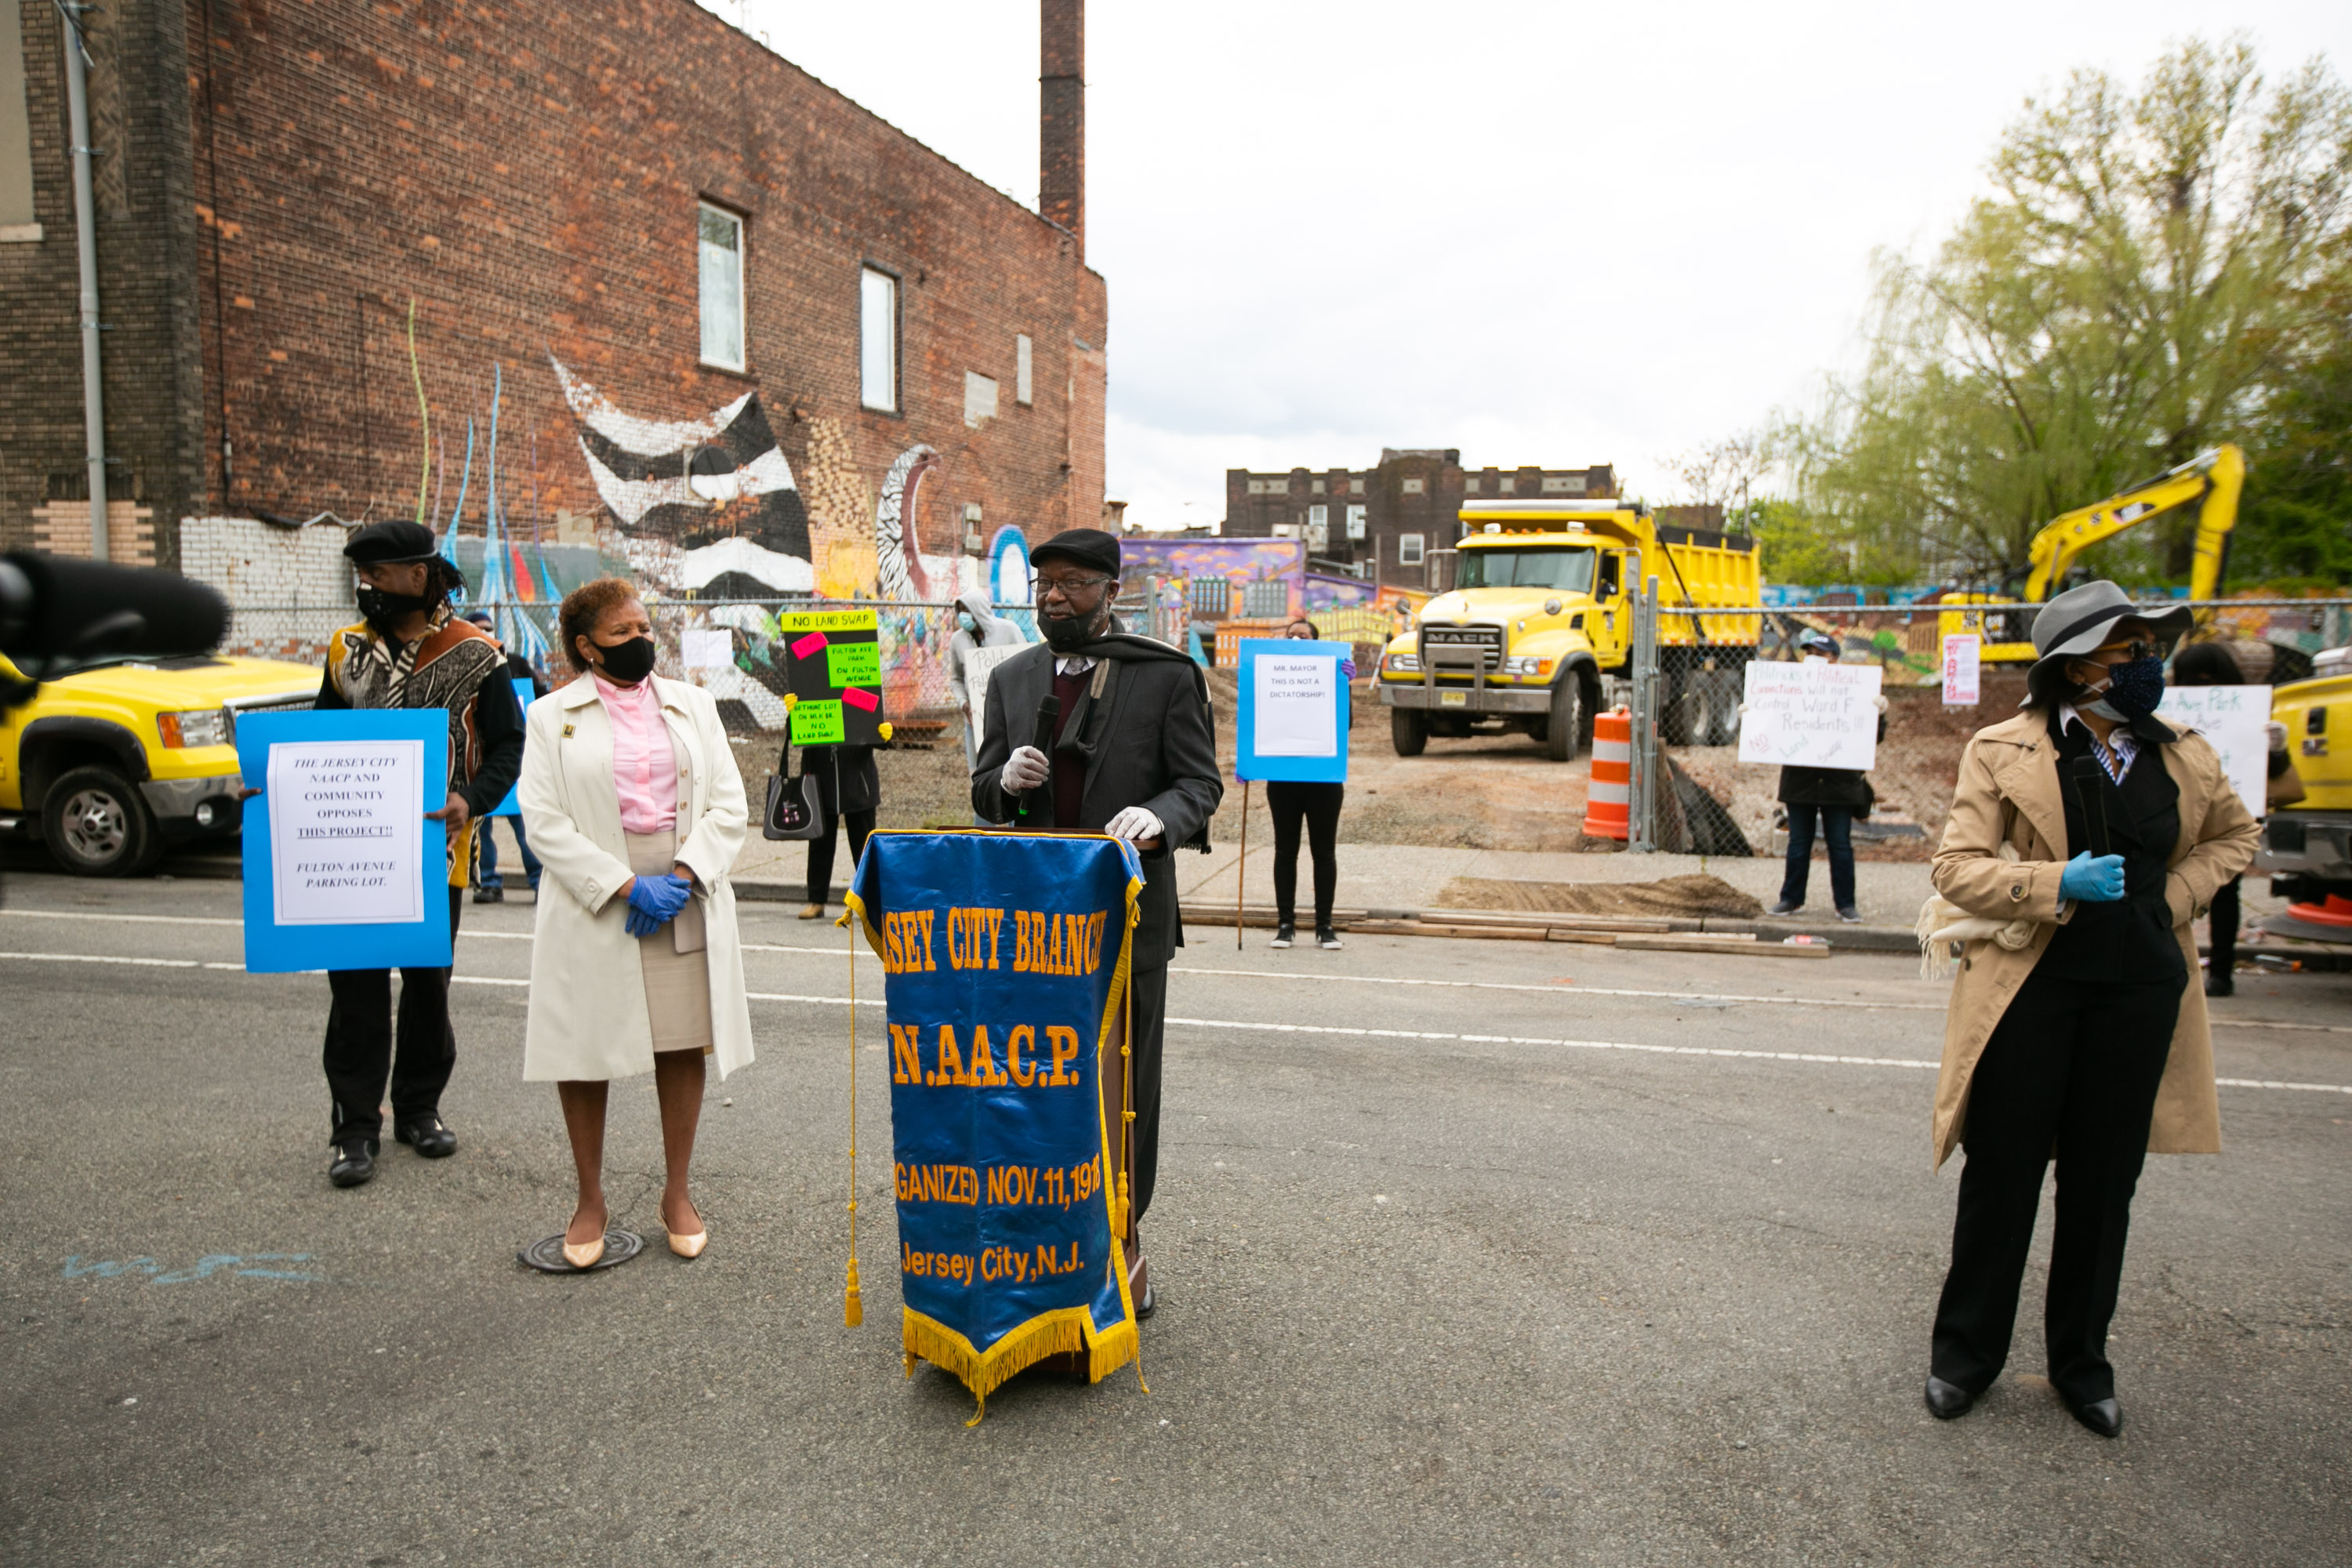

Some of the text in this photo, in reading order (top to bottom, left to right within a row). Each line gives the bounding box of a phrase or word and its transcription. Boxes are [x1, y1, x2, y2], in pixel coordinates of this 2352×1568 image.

[793, 615, 869, 626] NO LAND SWAP
[1428, 633, 1496, 642] MACK
[1802, 698, 1838, 713] Ward
[1844, 697, 1854, 713] F
[294, 757, 398, 768] THE JERSEY CITY
[309, 773, 380, 783] NAACP AND
[304, 790, 385, 801] COMMUNITY
[317, 808, 373, 818] OPPOSES
[297, 826, 393, 837] THIS PROJECT!!
[296, 861, 397, 873] FULTON AVENUE
[306, 877, 387, 888] PARKING LOT.
[948, 907, 1004, 970] CITY
[894, 1162, 979, 1205] GANIZED
[902, 1242, 975, 1286] Jersey
